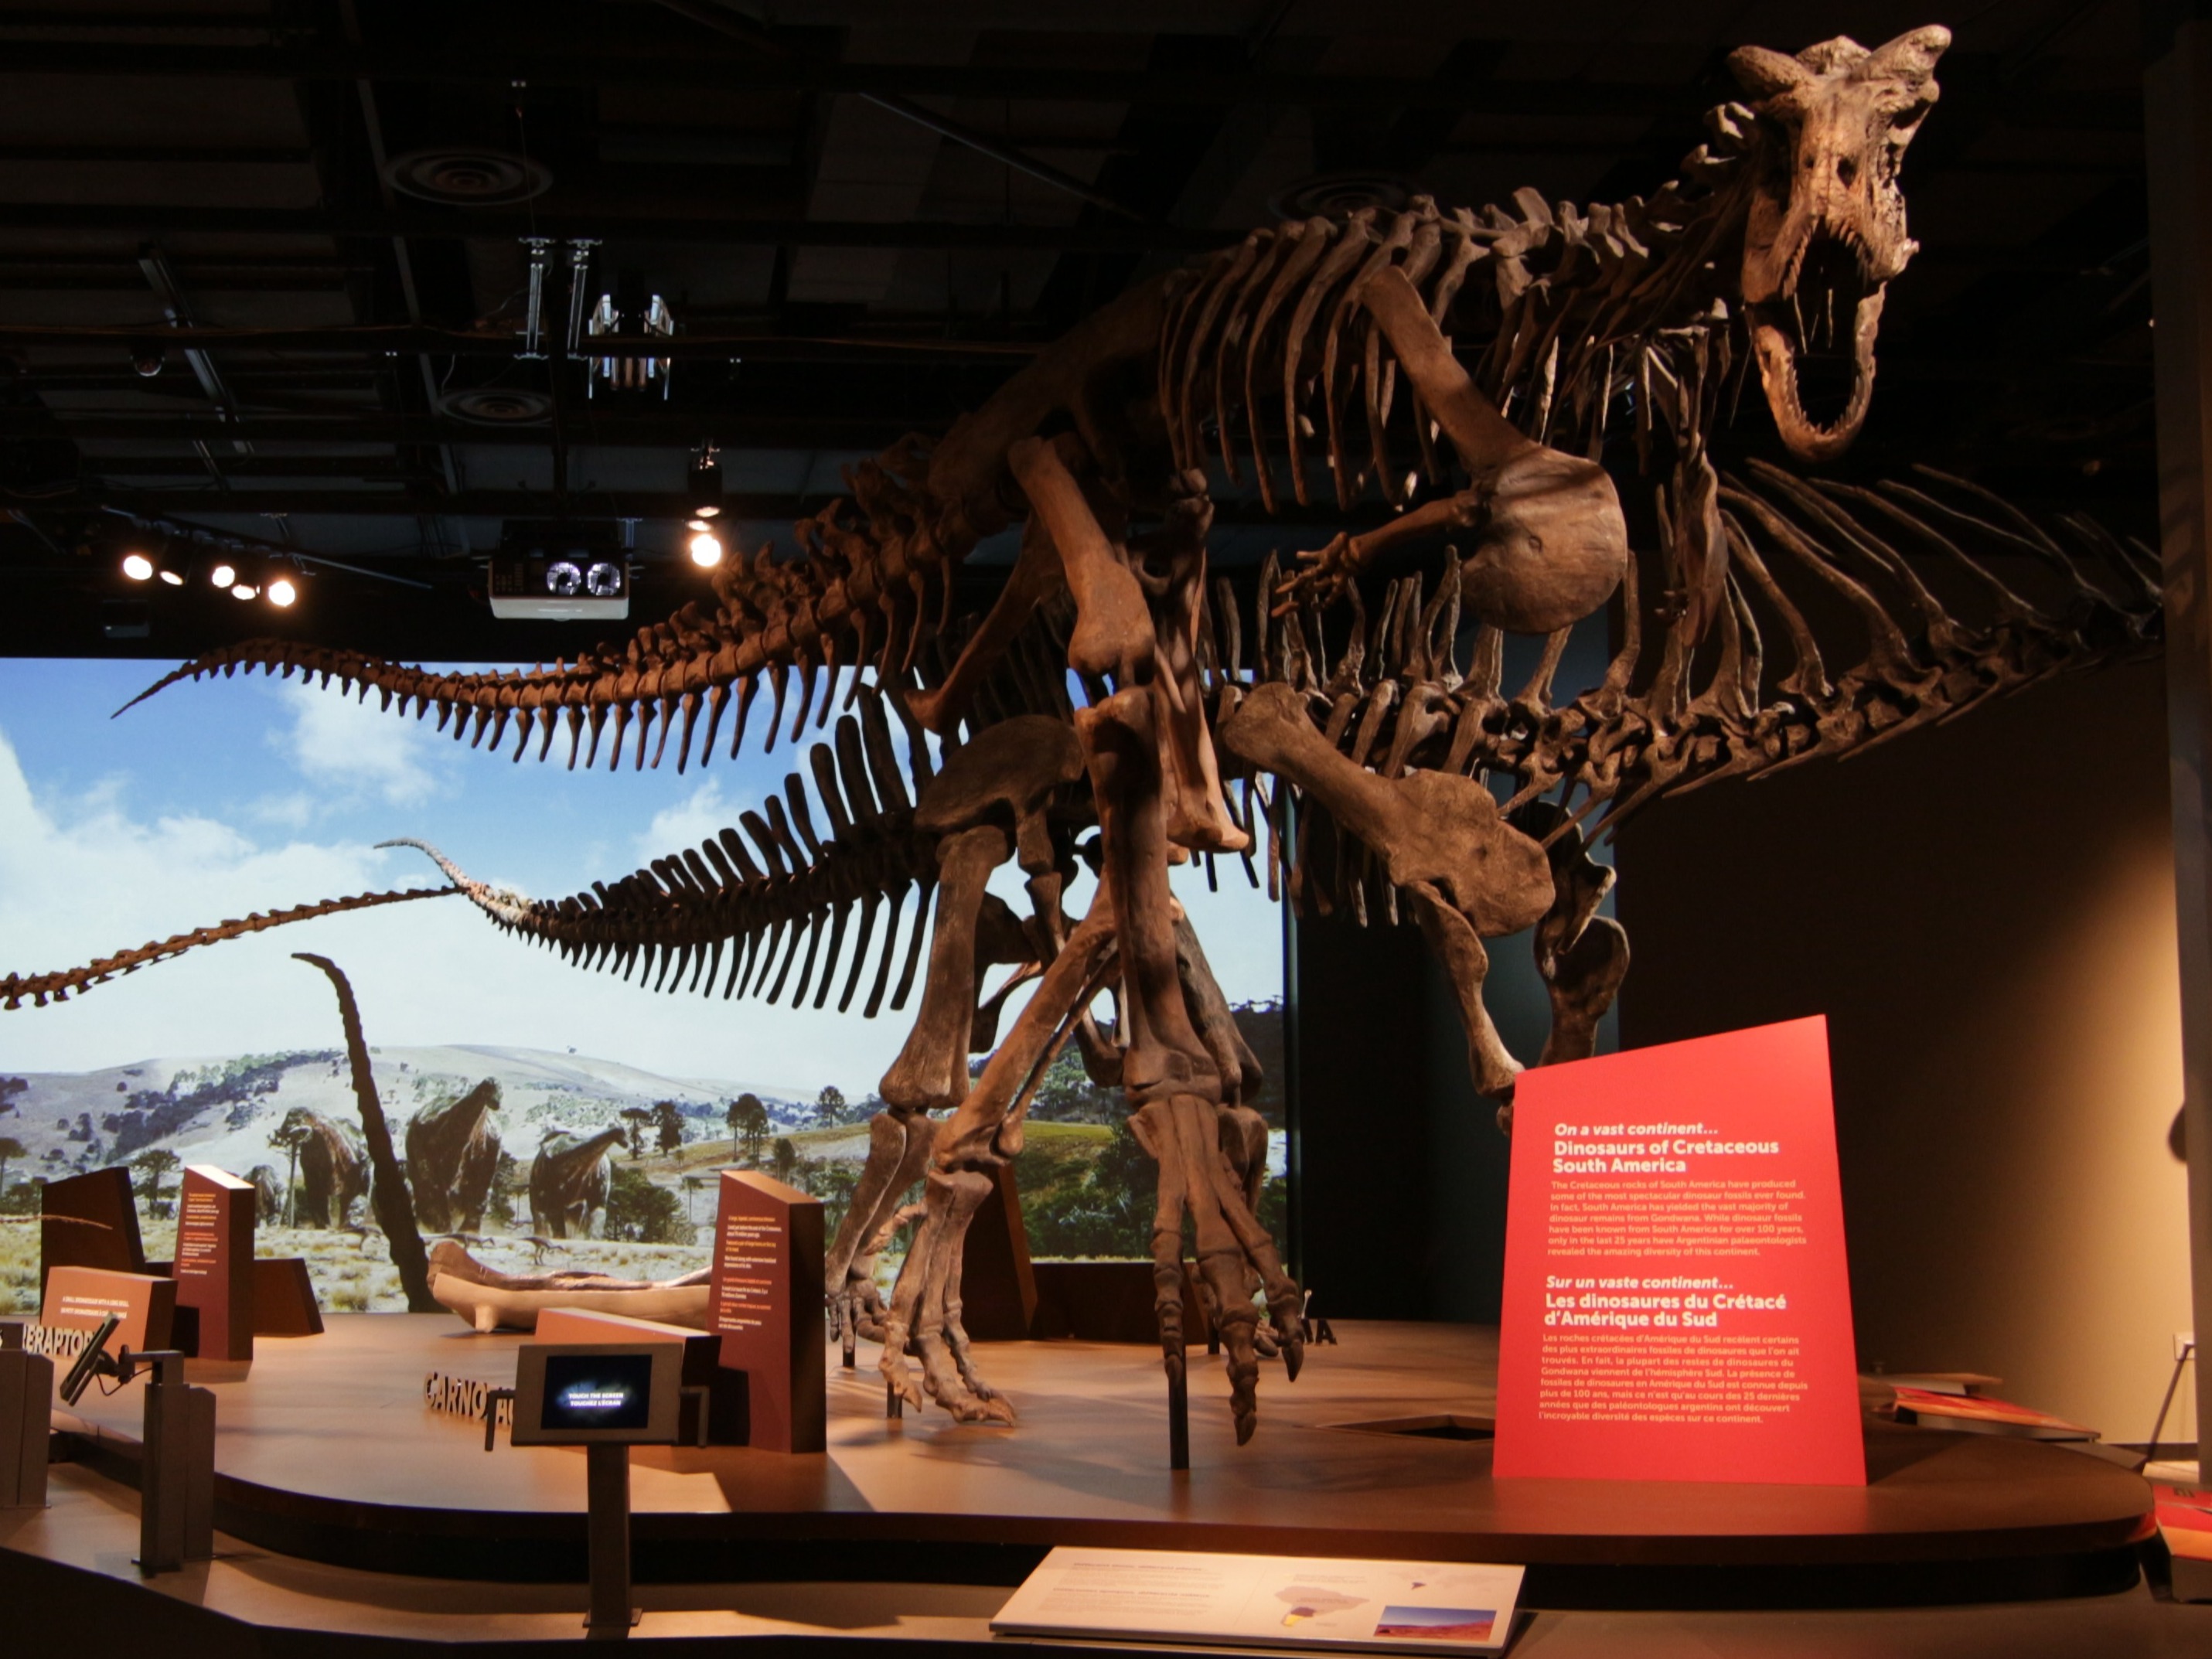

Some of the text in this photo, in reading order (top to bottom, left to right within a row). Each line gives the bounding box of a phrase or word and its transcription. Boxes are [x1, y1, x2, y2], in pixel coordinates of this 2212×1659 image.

[1555, 1123, 1576, 1136] On
[1580, 1126, 1589, 1136] a
[1593, 1123, 1624, 1135] vast
[1554, 1139, 1779, 1156] Dinosaurs of Cretaceous
[1552, 1157, 1686, 1173] South America
[1752, 1180, 1796, 1190] produced
[1629, 1192, 1680, 1201] spectacular
[1666, 1203, 1699, 1213] yielded
[1702, 1202, 1716, 1211] the
[1718, 1202, 1736, 1211] vast
[1739, 1202, 1776, 1212] majority
[1627, 1214, 1648, 1222] from
[1549, 1236, 1567, 1246] only
[1570, 1236, 1578, 1245] in
[1580, 1236, 1594, 1245] the
[1628, 1238, 1651, 1246] years
[1676, 1236, 1728, 1246] Argentinian
[1731, 1236, 1807, 1246] palaeontologists
[1604, 1248, 1641, 1257] amazing
[1644, 1248, 1681, 1257] diversity
[1546, 1276, 1573, 1288] Sur
[1575, 1278, 1595, 1288] un
[1599, 1276, 1638, 1289] vaste
[1546, 1293, 1786, 1309] Les dinosaures du Crétacé
[1654, 1312, 1677, 1326] du
[1682, 1311, 1717, 1327] Sud
[22, 1323, 95, 1357] ERAPTO
[1559, 1345, 1578, 1355] plus
[1749, 1348, 1766, 1357] que
[1627, 1358, 1661, 1367] plupart
[1740, 1370, 1781, 1379] présence
[1649, 1380, 1692, 1389] Amérique
[1778, 1381, 1808, 1391] depuis
[1540, 1390, 1558, 1399] plus
[1609, 1402, 1679, 1412] paléontologues
[1681, 1403, 1723, 1412] argentins
